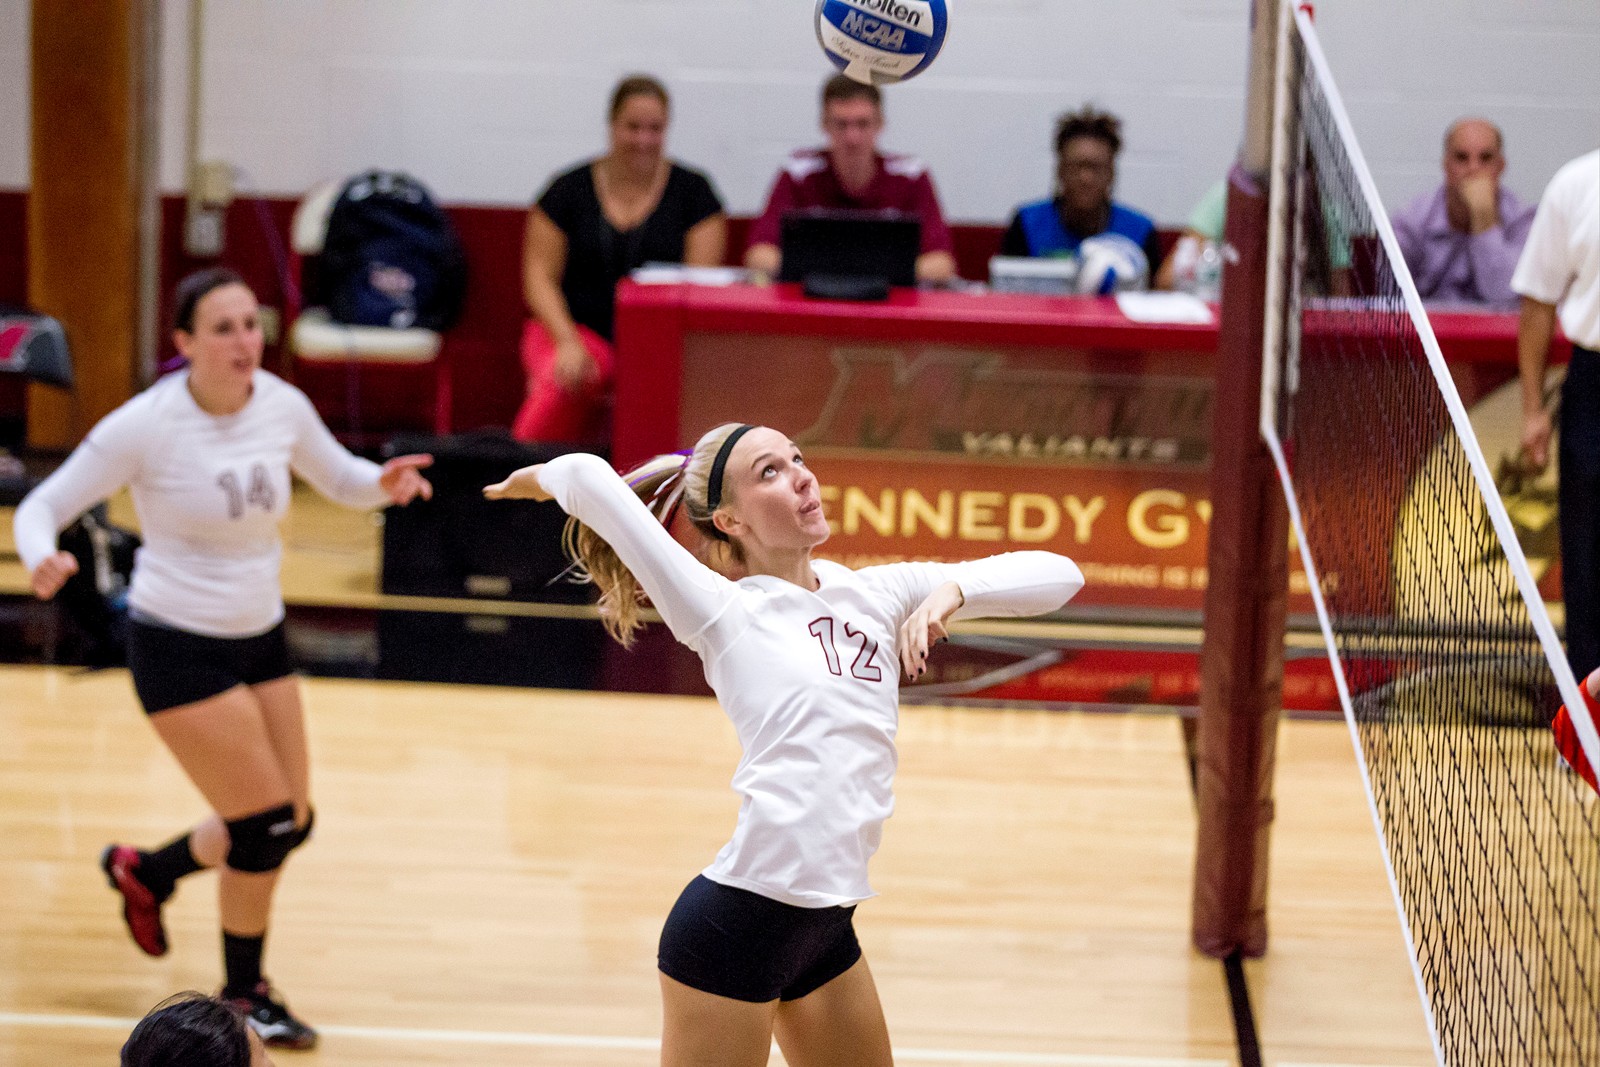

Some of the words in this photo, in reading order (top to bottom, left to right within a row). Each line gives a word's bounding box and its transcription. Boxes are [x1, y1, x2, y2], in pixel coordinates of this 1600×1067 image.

[840, 9, 906, 51] NCAA
[962, 430, 1180, 461] VALIANTS
[214, 463, 276, 519] 14
[819, 485, 1106, 545] ENNEDY
[808, 616, 882, 682] 12
